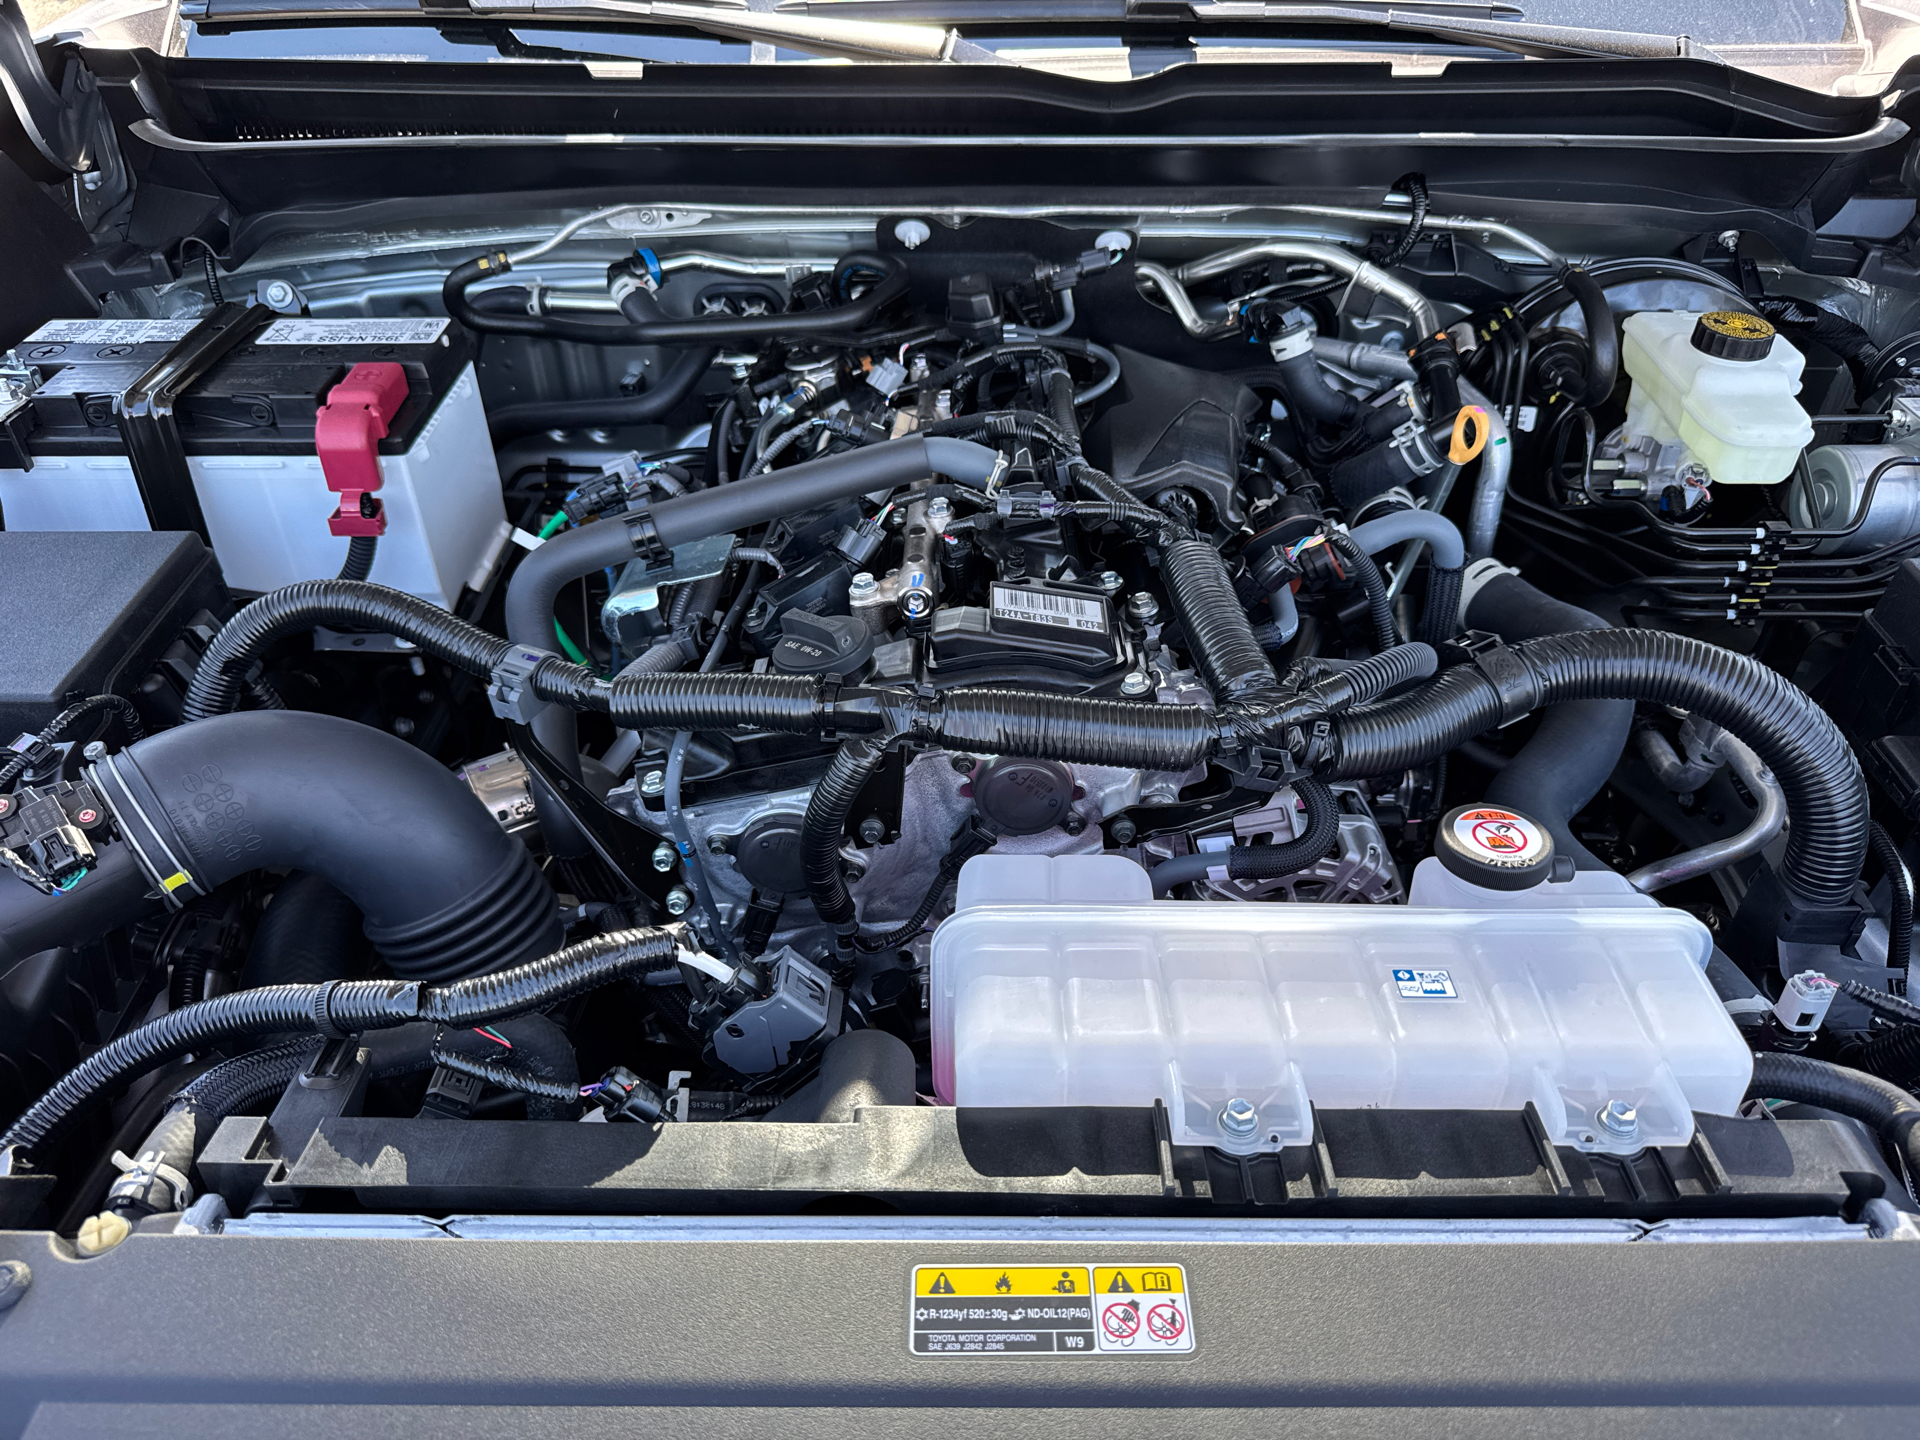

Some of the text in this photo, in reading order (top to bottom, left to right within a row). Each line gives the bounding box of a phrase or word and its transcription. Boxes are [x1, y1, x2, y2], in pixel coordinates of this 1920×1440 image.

[1081, 621, 1099, 630] 042
[785, 641, 822, 657] SAE 0W-20
[1485, 857, 1537, 868] DENSO
[929, 1307, 1091, 1321] R-1234yf 520±30g ND-OIL12(PAG)
[928, 1334, 1037, 1342] TOYOTA MOTOR CORPORATION
[1064, 1336, 1085, 1348] W9
[928, 1343, 943, 1351] SAE
[945, 1343, 961, 1351] J639
